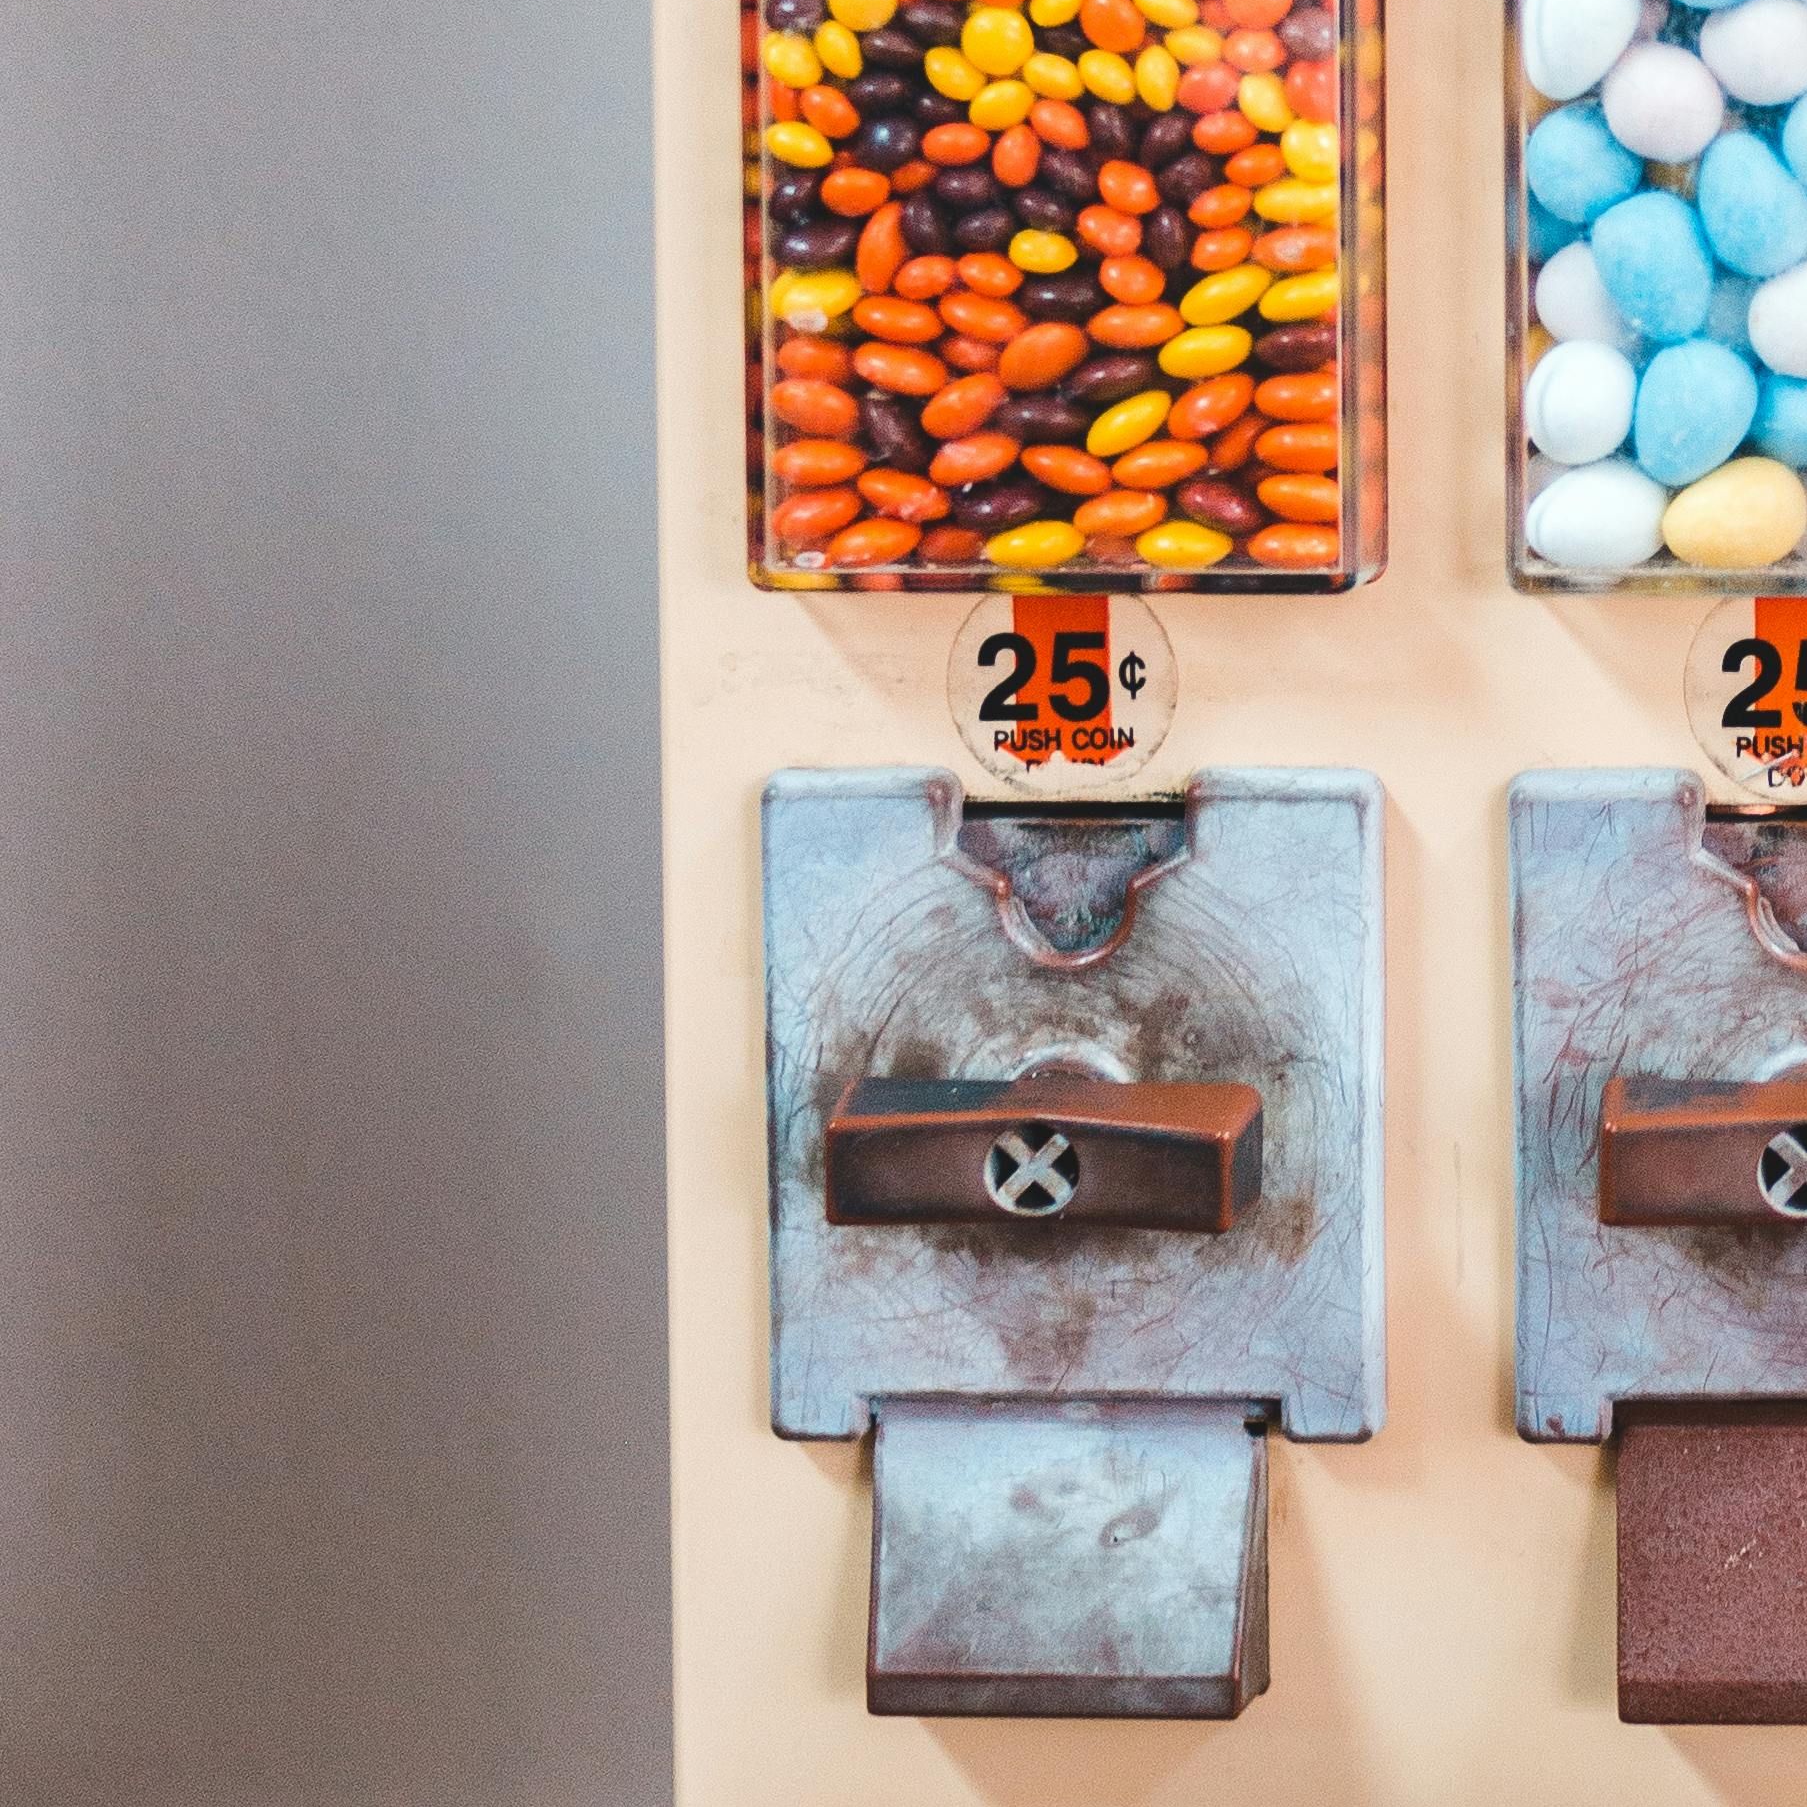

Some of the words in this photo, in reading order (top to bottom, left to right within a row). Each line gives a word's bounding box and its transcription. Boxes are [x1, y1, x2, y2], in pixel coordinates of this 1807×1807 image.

[994, 728, 1062, 752] PUSH
[1071, 726, 1135, 750] COIN
[1735, 735, 1804, 758] PUSH
